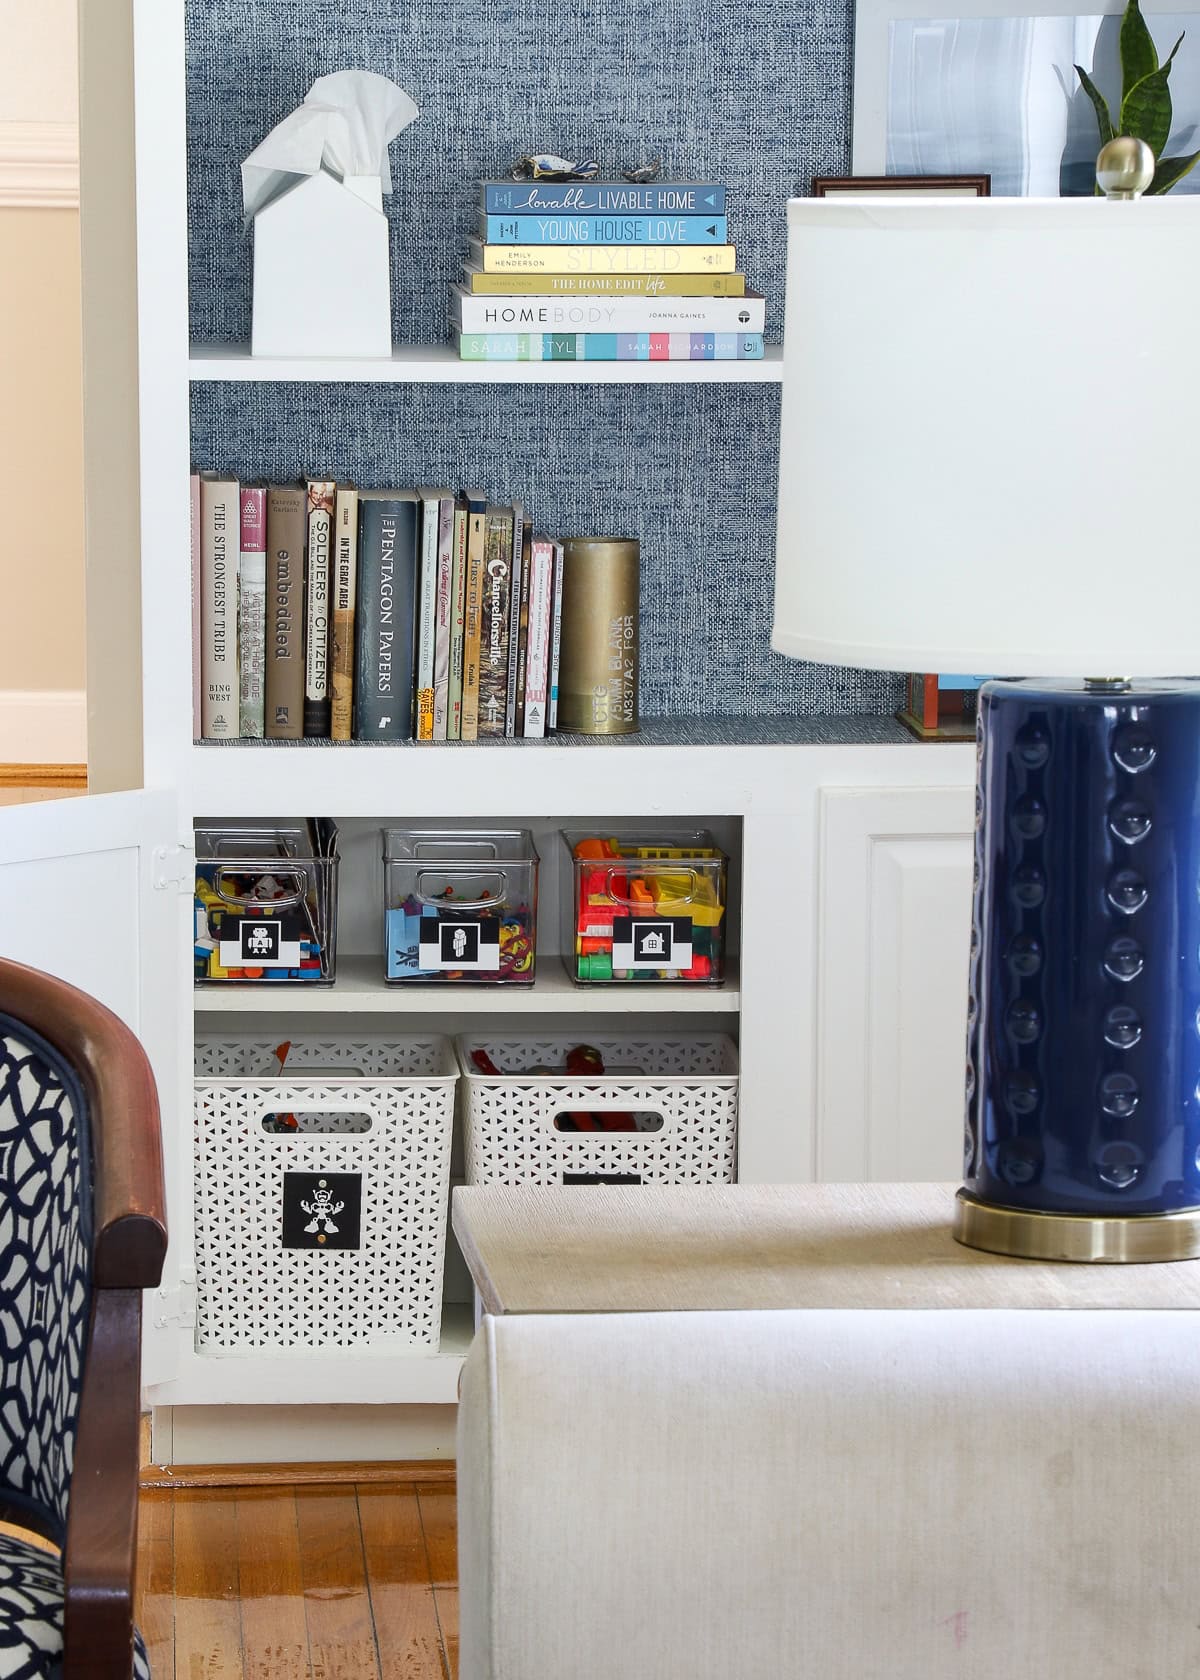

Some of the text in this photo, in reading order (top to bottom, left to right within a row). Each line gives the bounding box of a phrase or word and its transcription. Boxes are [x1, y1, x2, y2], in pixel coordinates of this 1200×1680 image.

[514, 189, 596, 210] lovable
[598, 191, 653, 209] LIVABLE
[658, 191, 696, 209] HOME
[538, 220, 589, 241] YOUNG
[594, 220, 642, 241] HOUSE
[648, 220, 687, 241] LOVE
[567, 248, 681, 271] STYLED
[552, 274, 666, 295] THE HOME EDIT life
[471, 341, 584, 353] SARAH STYLE
[214, 504, 226, 662] THE STRONGEST TRIBE
[339, 538, 349, 609] IN THE GRAY AREA
[276, 550, 292, 660] embedded
[315, 521, 328, 690] SOLDIERS to CITIZENS
[378, 528, 396, 692] PENTAGON PAPERS
[440, 597, 448, 627] Command
[468, 559, 481, 637] FIRST TO FIGHT
[488, 559, 507, 665] Chancellorsville
[511, 594, 519, 636] GENERATION
[252, 592, 260, 698] VICTORY AT HIGH TIDE
[210, 684, 230, 692] BING
[608, 616, 623, 721] 75MM BLANK
[624, 615, 634, 722] M337A2 FOR
[209, 694, 230, 702] WEST
[421, 688, 430, 714] SAVES
[593, 685, 608, 723] CTG
